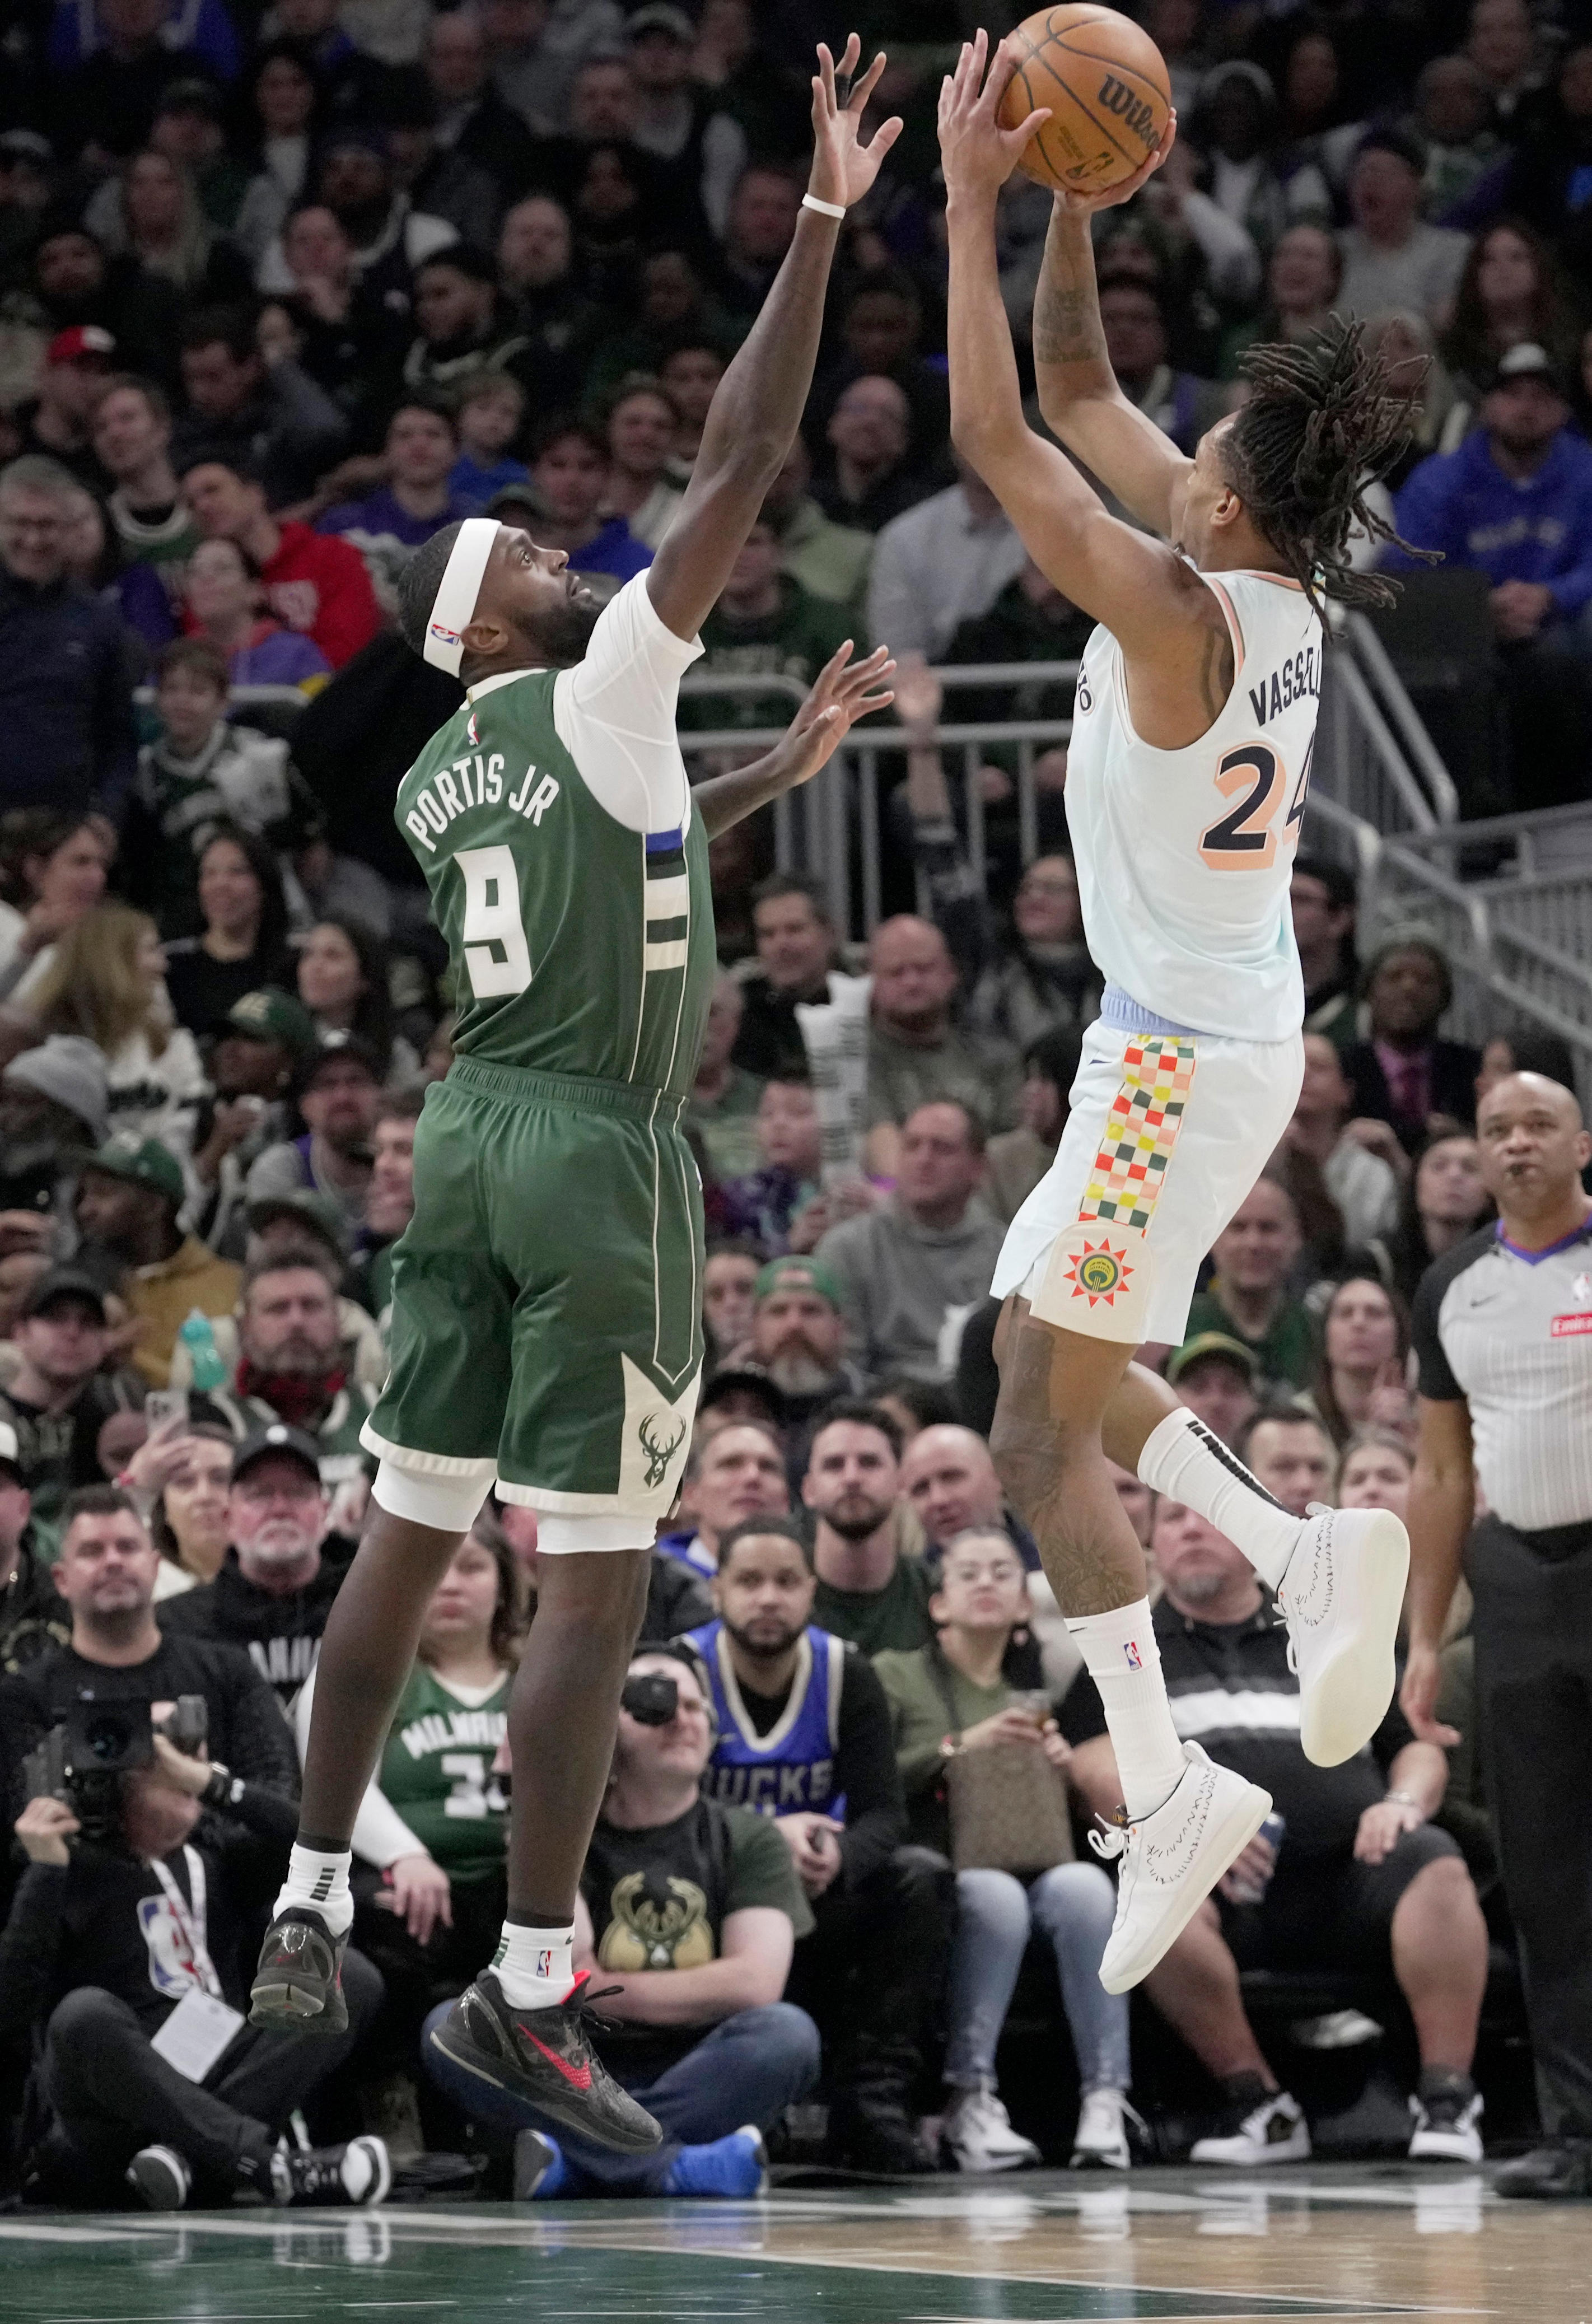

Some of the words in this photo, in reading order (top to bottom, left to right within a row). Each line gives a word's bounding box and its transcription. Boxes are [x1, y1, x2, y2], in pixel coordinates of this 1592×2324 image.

[406, 754, 505, 853] PORTIS
[508, 764, 559, 827] JR
[1197, 729, 1316, 871] 24
[453, 844, 533, 999] 9
